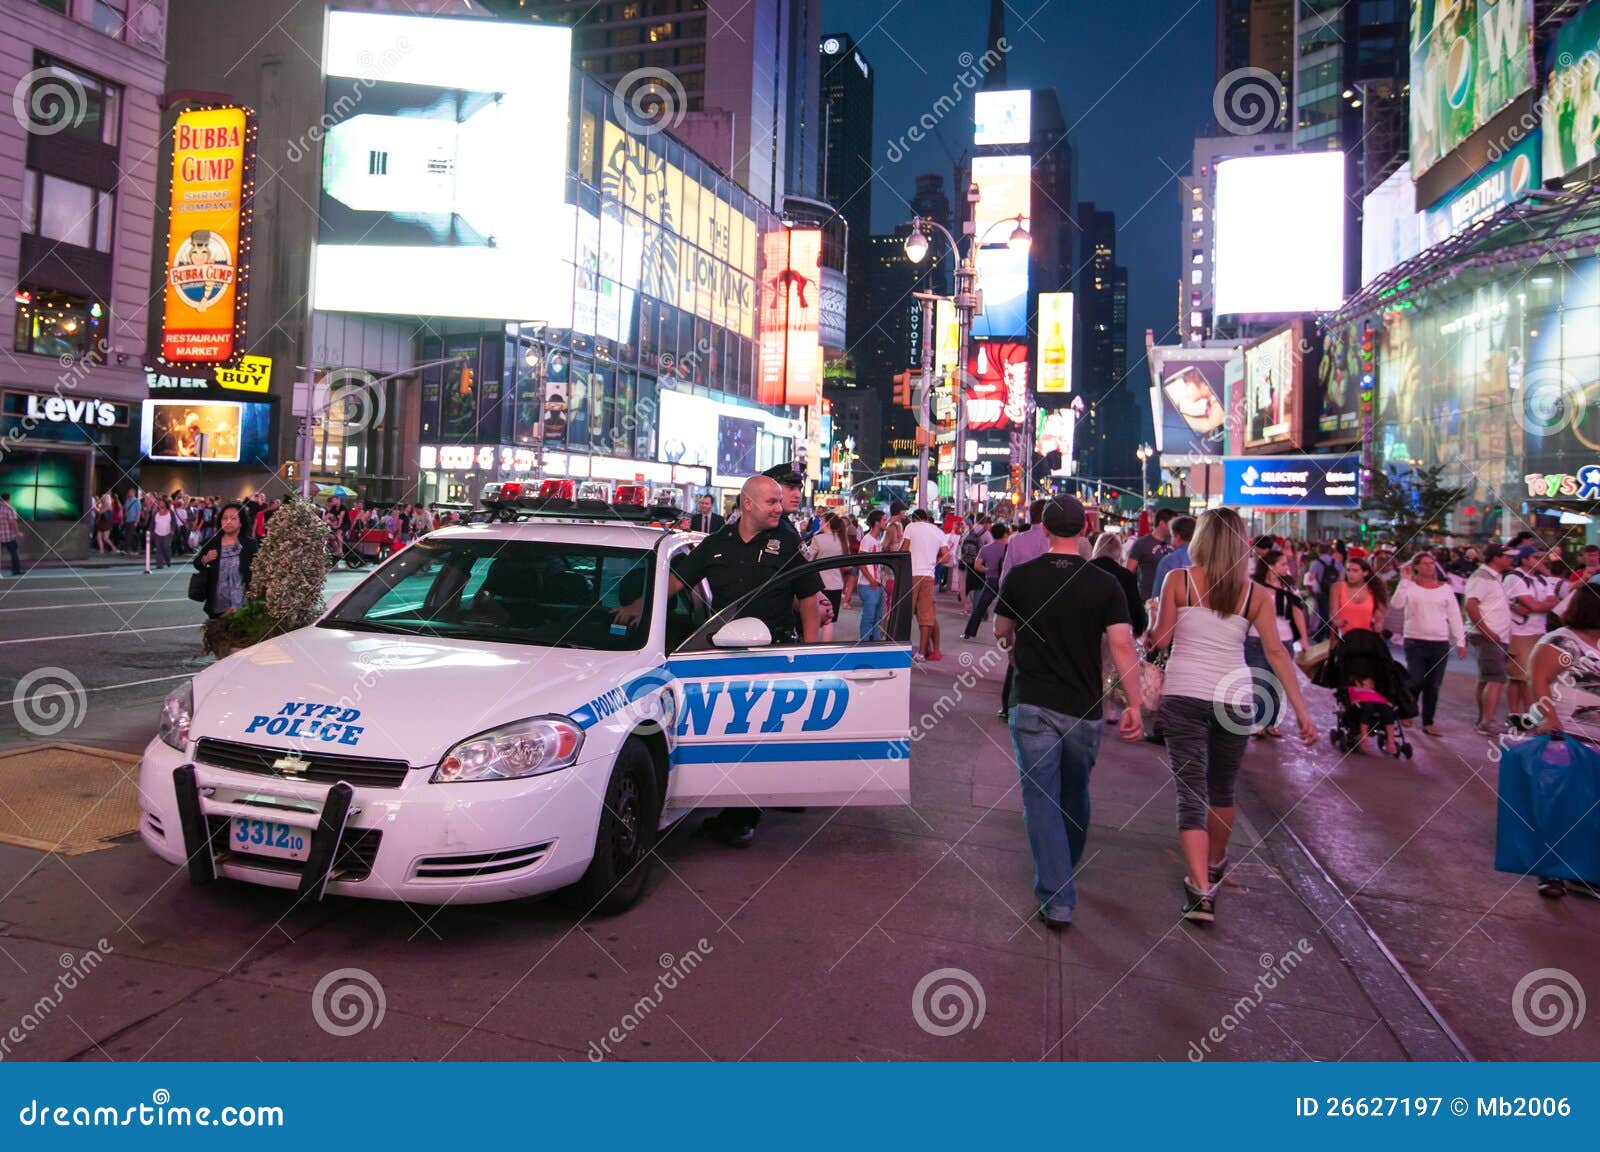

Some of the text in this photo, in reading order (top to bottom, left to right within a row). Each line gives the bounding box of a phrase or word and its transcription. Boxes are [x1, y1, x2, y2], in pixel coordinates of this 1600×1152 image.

[178, 125, 240, 151] BUBBA
[182, 157, 234, 182] GUMP
[178, 201, 234, 212] COMPANY
[184, 189, 230, 200] SHRIMP
[709, 217, 728, 249] THE
[173, 265, 232, 283] BUBBA GUMP
[166, 333, 231, 344] RESTAURANT
[910, 306, 919, 365] NOVOTEL
[176, 346, 219, 356] MARKET
[223, 372, 262, 386] BUY
[277, 702, 361, 723] NYPD
[591, 686, 628, 721] POLICE
[676, 679, 850, 736] NYPD
[245, 716, 364, 745] POLICE
[235, 818, 303, 850] 3312 10
